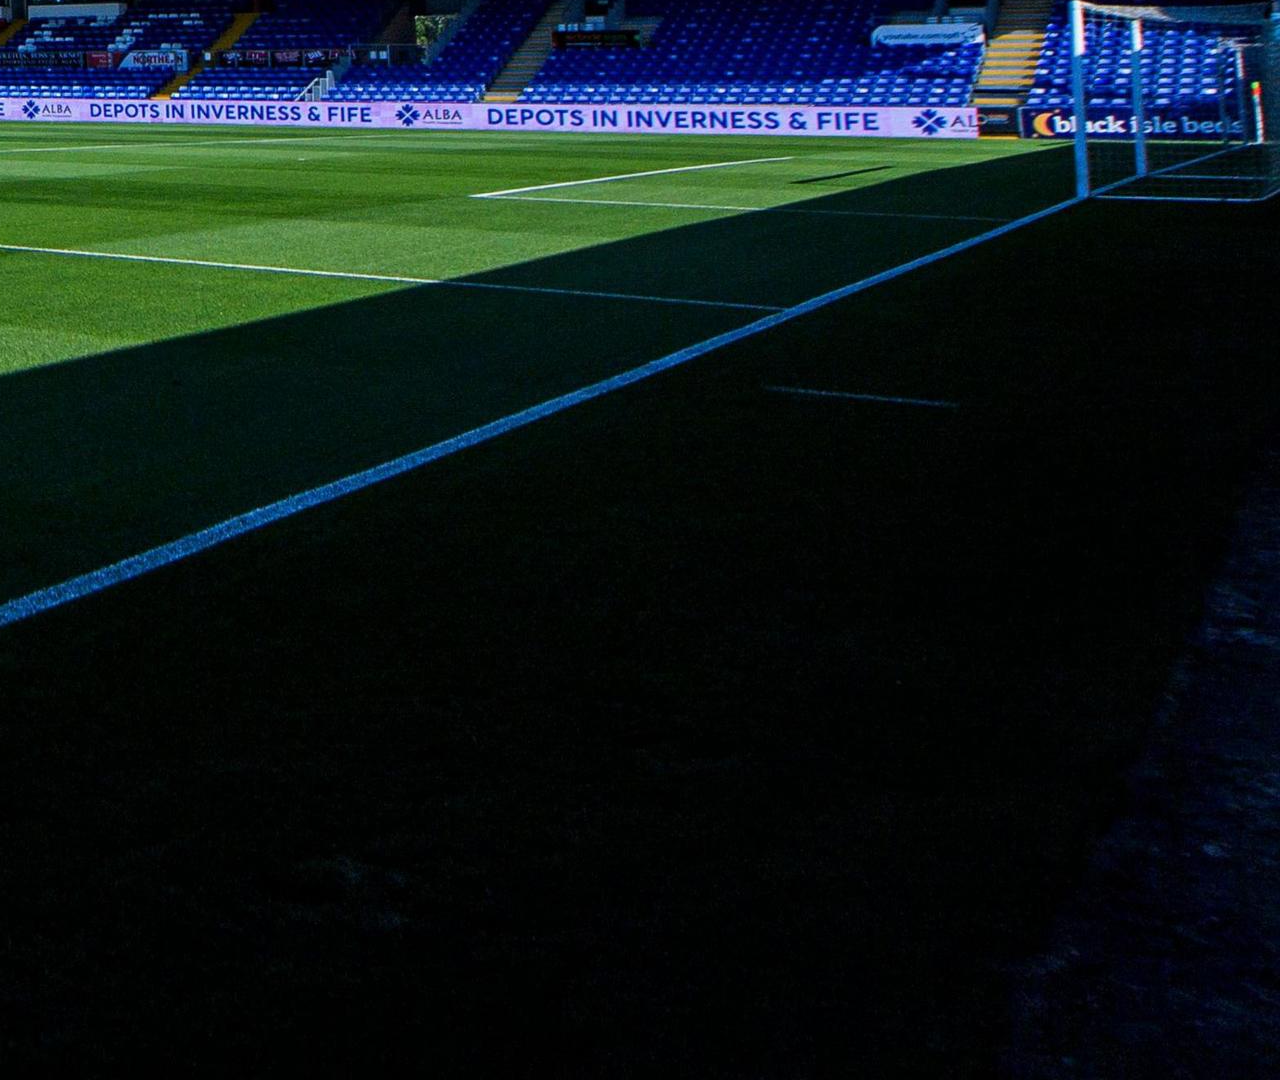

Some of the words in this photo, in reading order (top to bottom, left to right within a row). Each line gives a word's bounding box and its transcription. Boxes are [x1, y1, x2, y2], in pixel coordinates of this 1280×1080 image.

[42, 104, 72, 114] ALBA
[90, 104, 159, 118] DEPOTS
[166, 104, 184, 119] IN
[191, 104, 301, 120] INVERNESS
[308, 106, 320, 121] &
[328, 107, 372, 122] FIFE
[422, 108, 462, 120] ALBA
[487, 109, 584, 126] DEPOTS
[593, 110, 617, 127] IN
[627, 110, 780, 130] INVERNESS
[789, 111, 807, 130] &
[818, 111, 880, 131] FIFE
